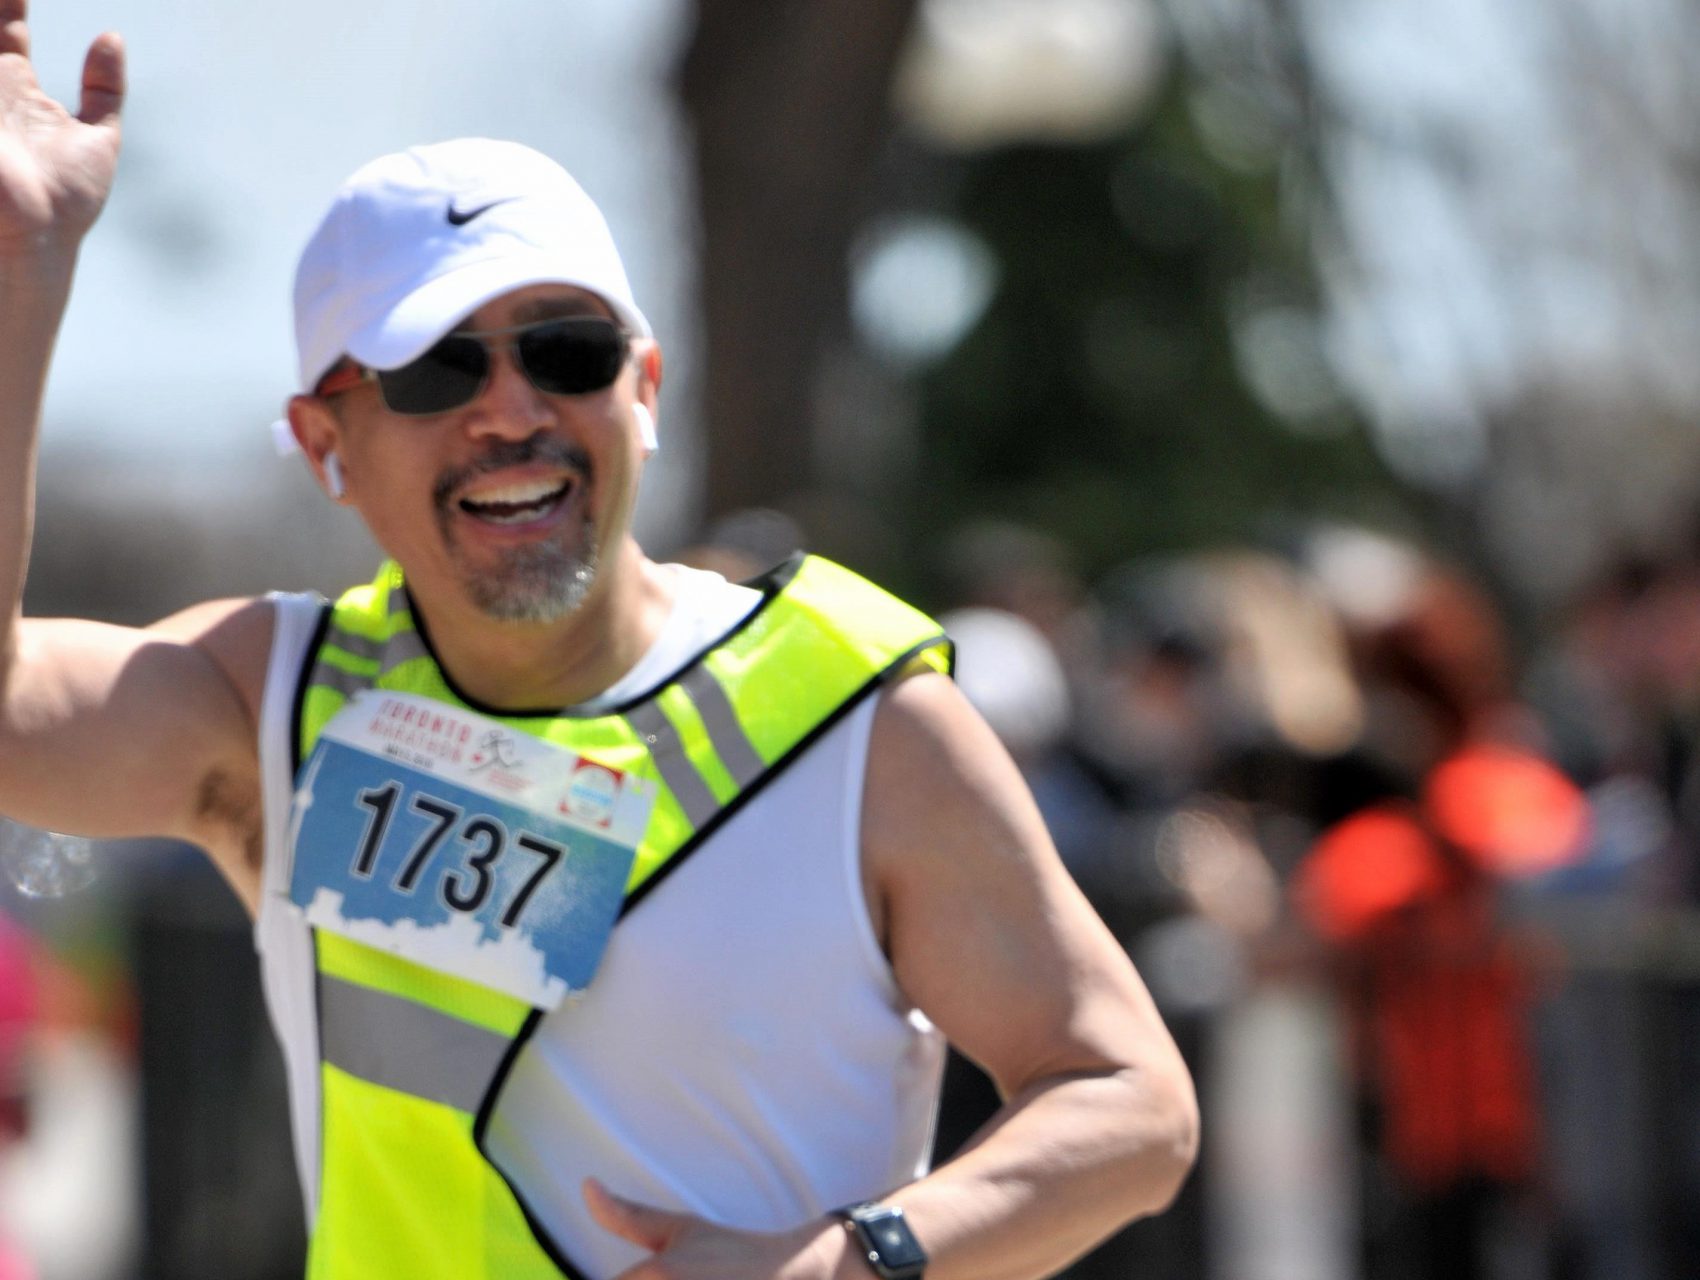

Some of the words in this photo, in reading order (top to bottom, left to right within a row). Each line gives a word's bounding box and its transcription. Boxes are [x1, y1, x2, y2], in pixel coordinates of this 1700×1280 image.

[369, 717, 463, 763] MARATHON
[380, 699, 472, 743] TORONTO
[352, 781, 564, 928] 1737
